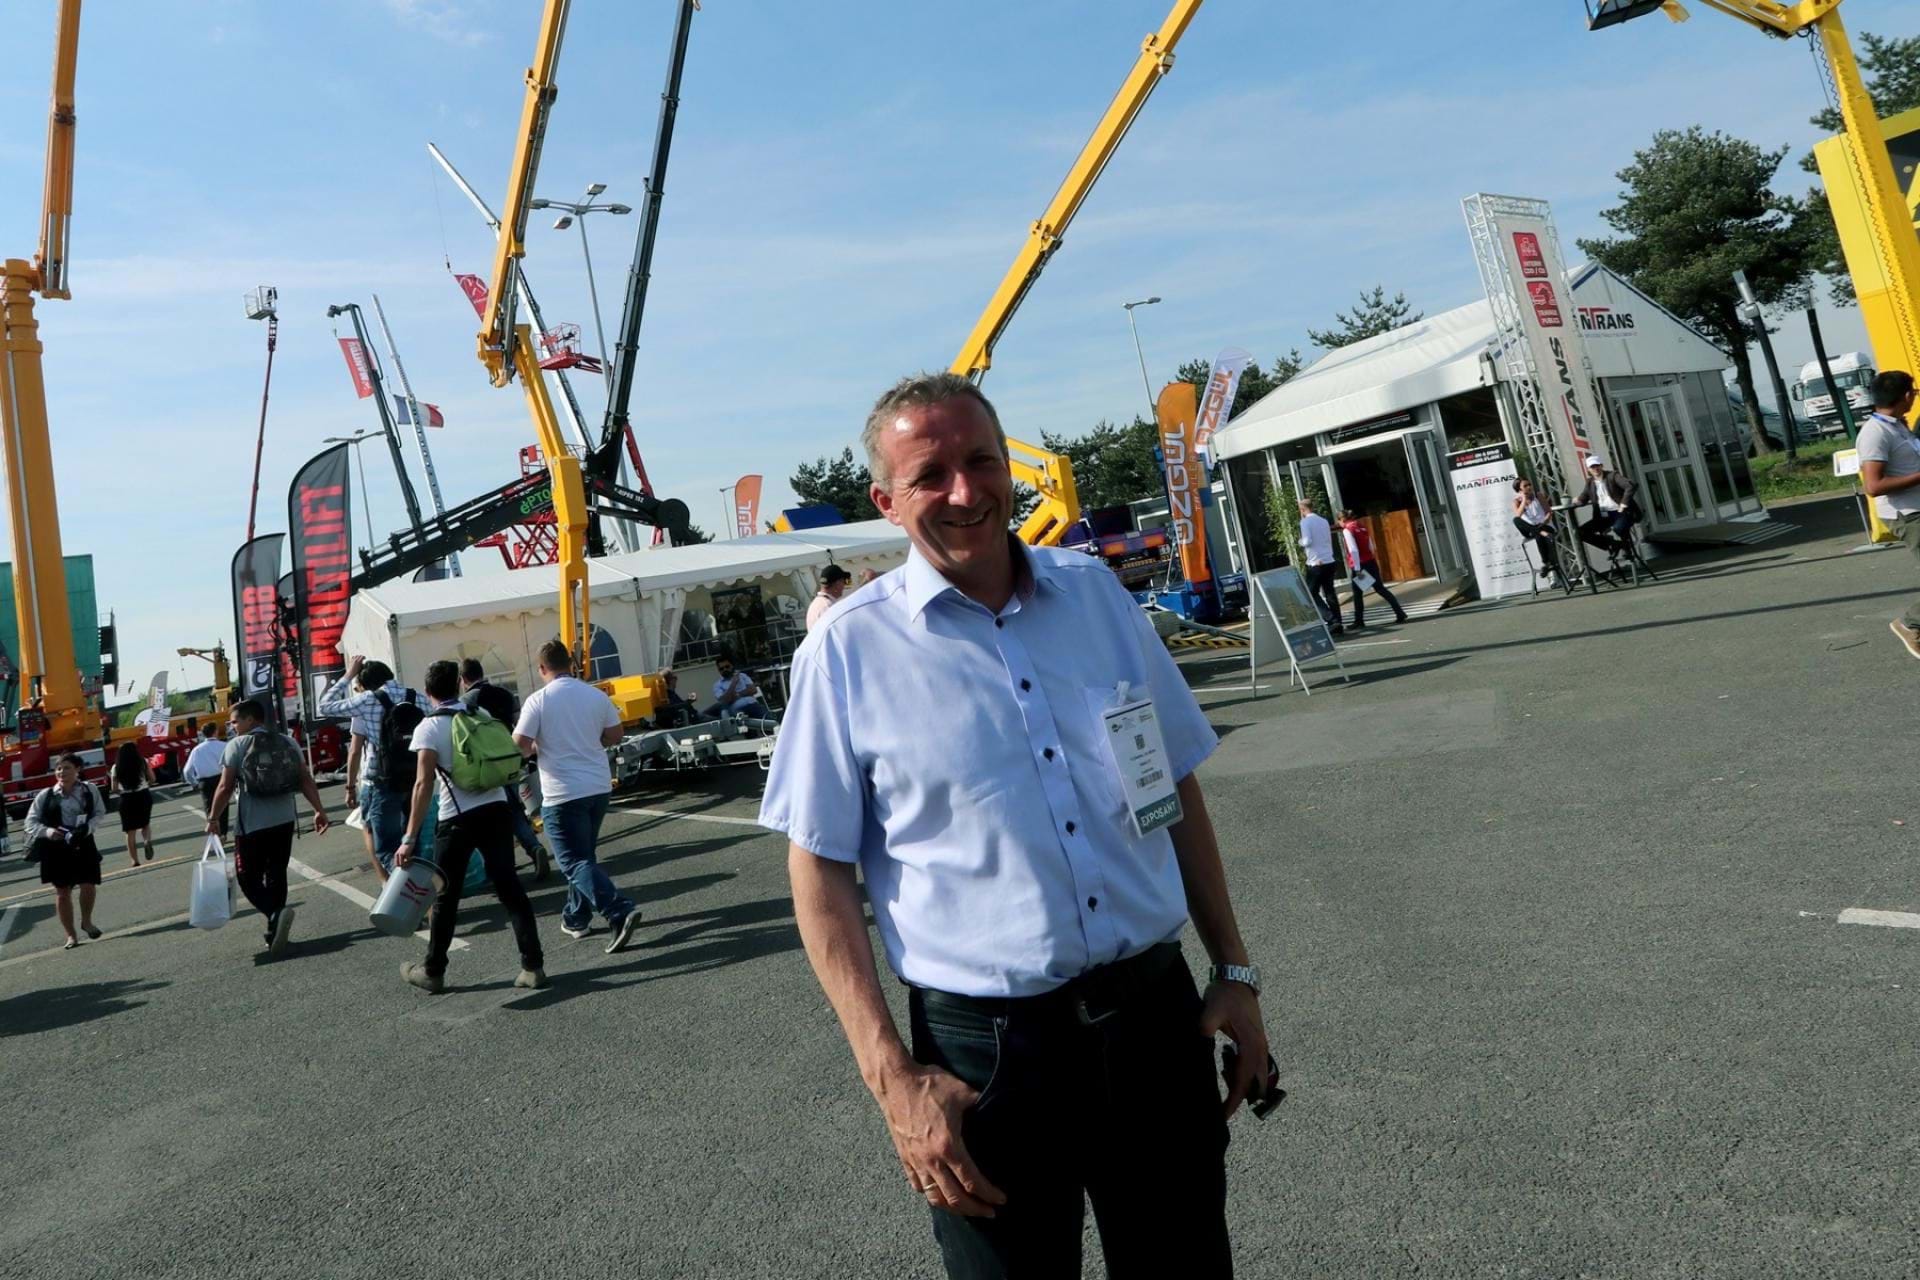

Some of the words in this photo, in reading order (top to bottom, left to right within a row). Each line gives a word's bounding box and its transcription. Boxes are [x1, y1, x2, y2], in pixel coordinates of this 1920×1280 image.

[1578, 307, 1634, 330] NTRANS
[1549, 336, 1591, 481] TRANS
[1456, 474, 1516, 491] MANTRANS
[300, 484, 349, 666] MULTILIFT
[242, 584, 276, 654] HIAB
[1140, 801, 1176, 826] EXPOSANT
